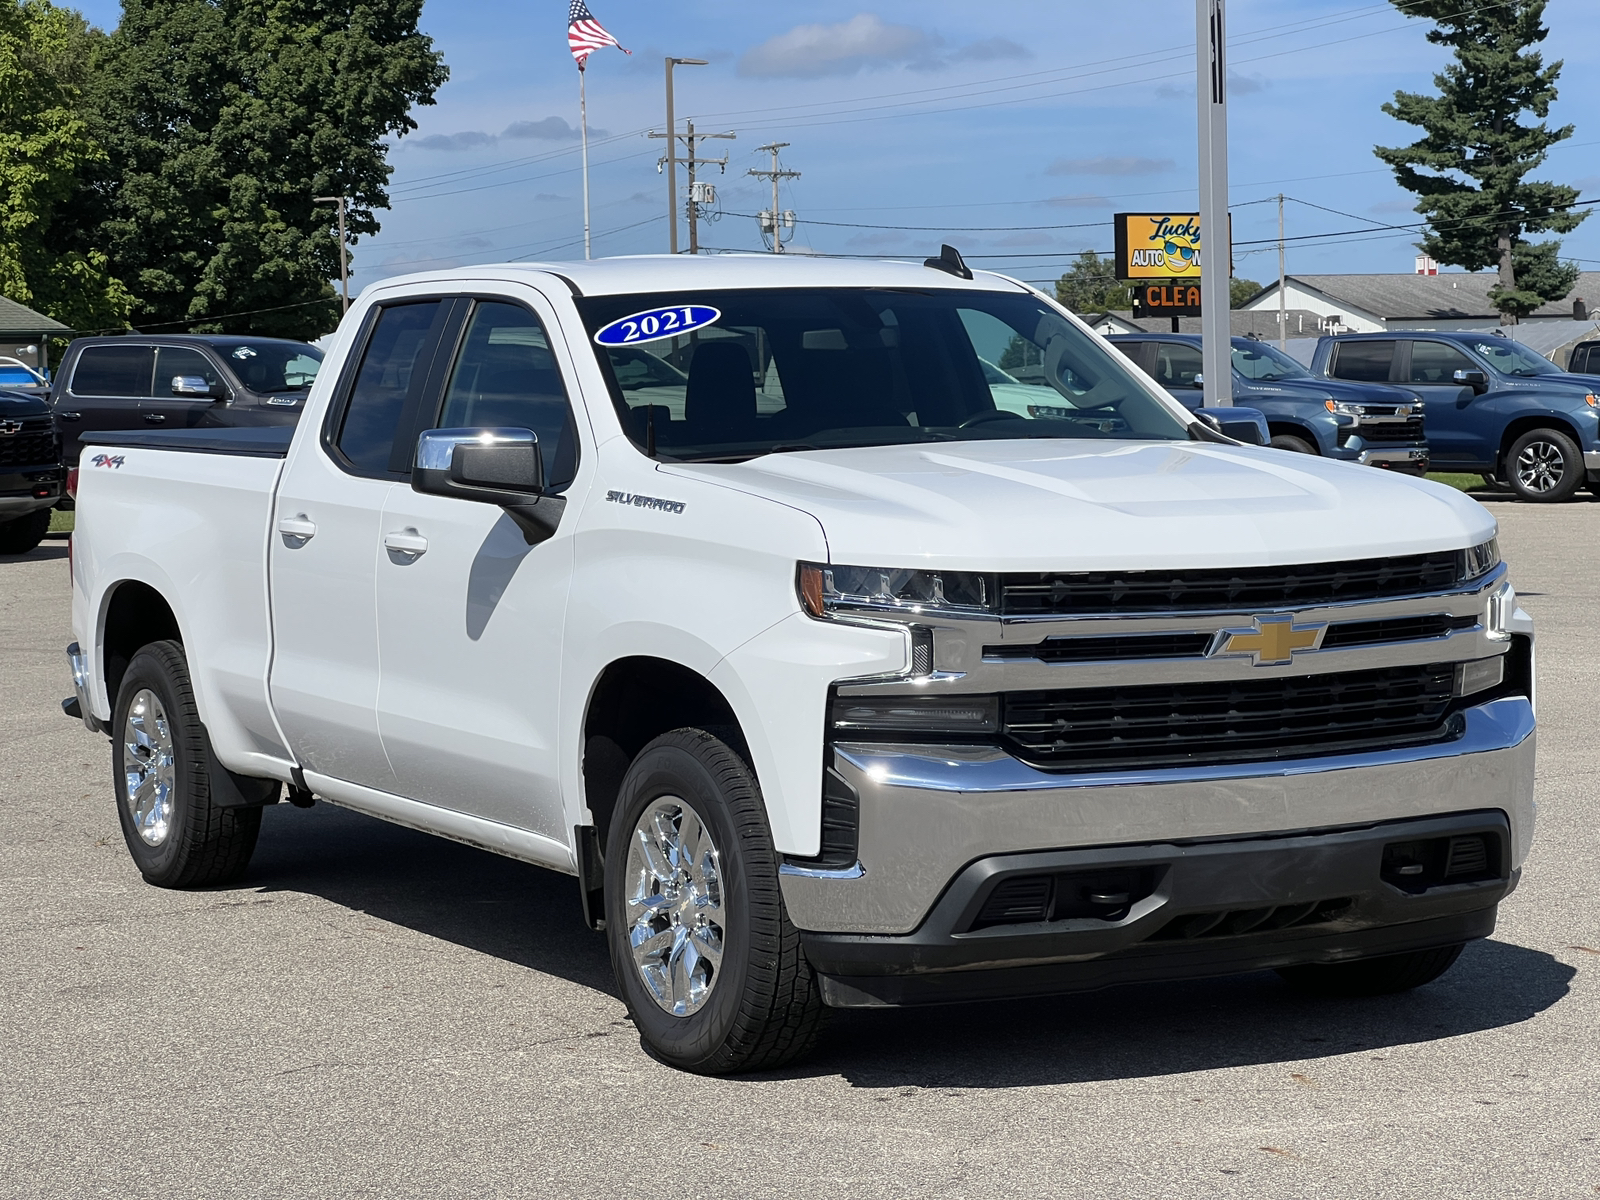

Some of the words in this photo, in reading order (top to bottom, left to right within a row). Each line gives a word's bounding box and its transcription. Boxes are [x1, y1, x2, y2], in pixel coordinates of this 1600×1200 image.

[1131, 249, 1164, 266] AUTO
[1146, 286, 1200, 307] CLEA
[620, 307, 697, 342] 2021
[605, 490, 687, 515] SILVERADO
